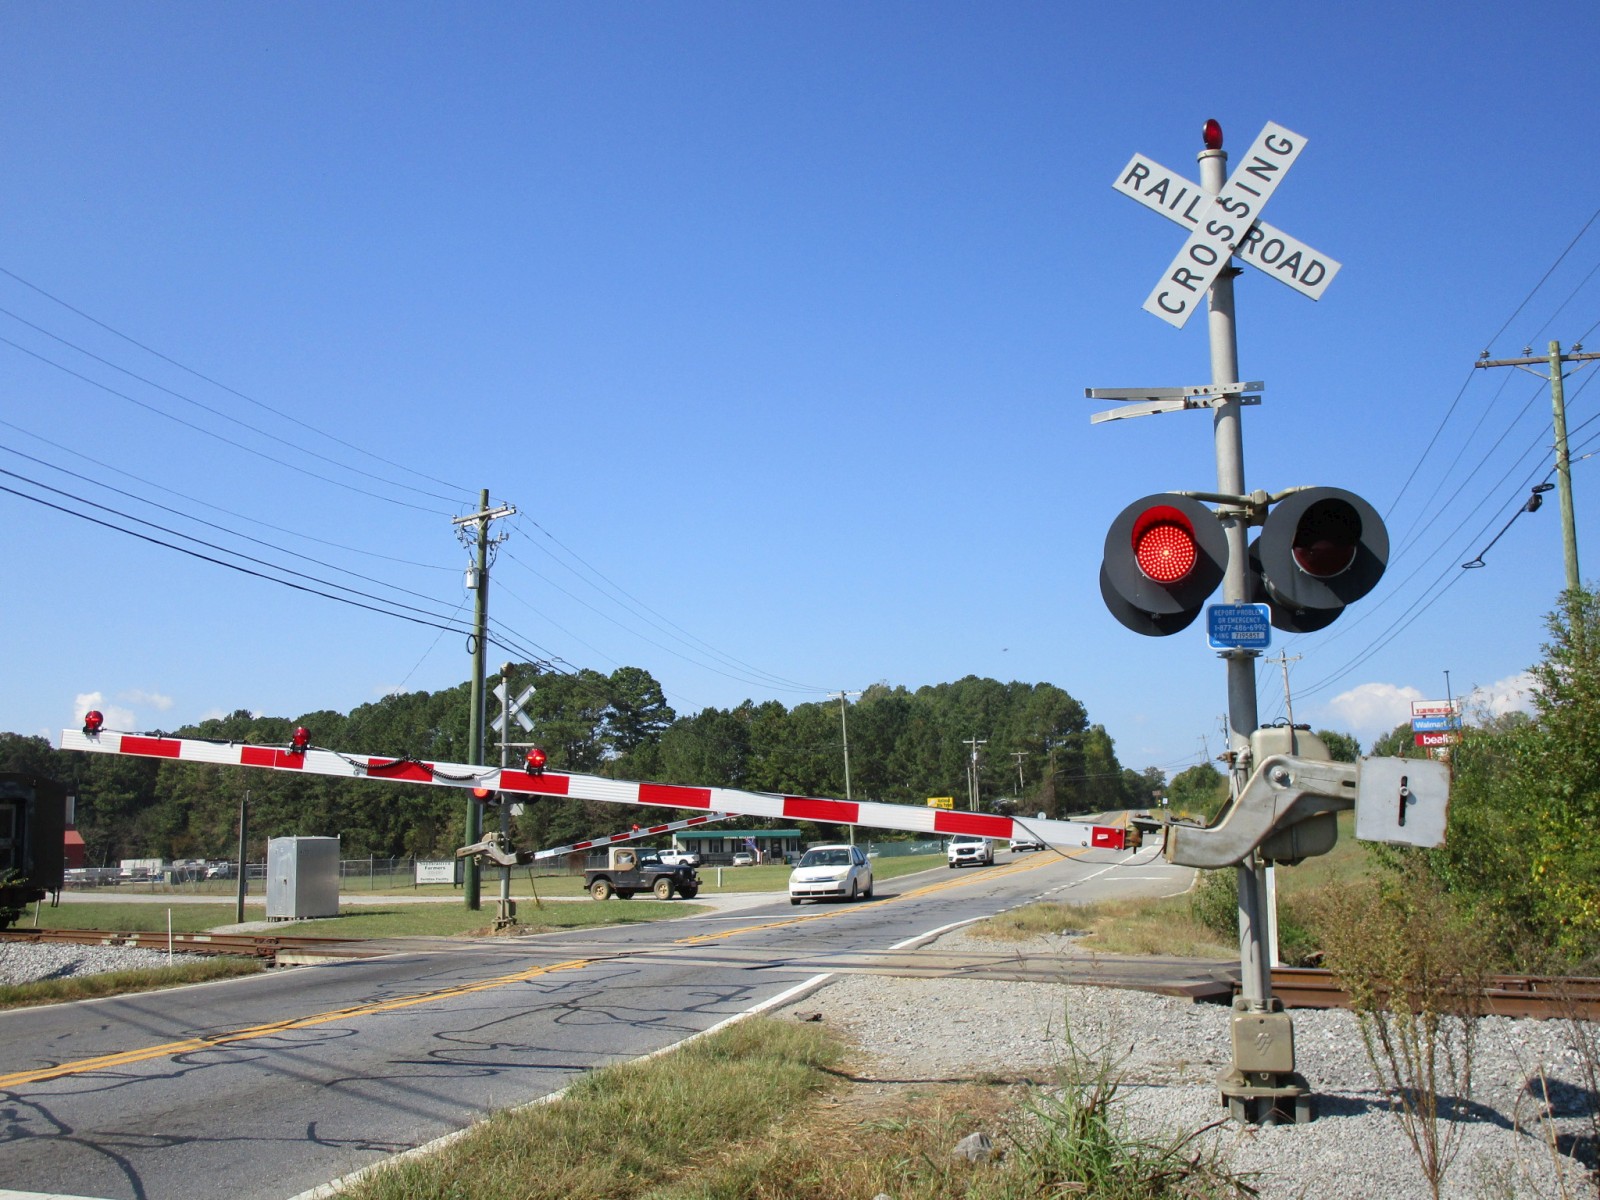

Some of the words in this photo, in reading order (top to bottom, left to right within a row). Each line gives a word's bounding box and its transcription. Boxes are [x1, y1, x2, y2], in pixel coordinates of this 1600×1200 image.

[1123, 162, 1202, 224] RAIL
[1241, 225, 1326, 287] ROAD
[1157, 134, 1294, 315] CROSSING
[1214, 624, 1267, 632] 1-877-486-6992
[1415, 720, 1447, 729] Walmart
